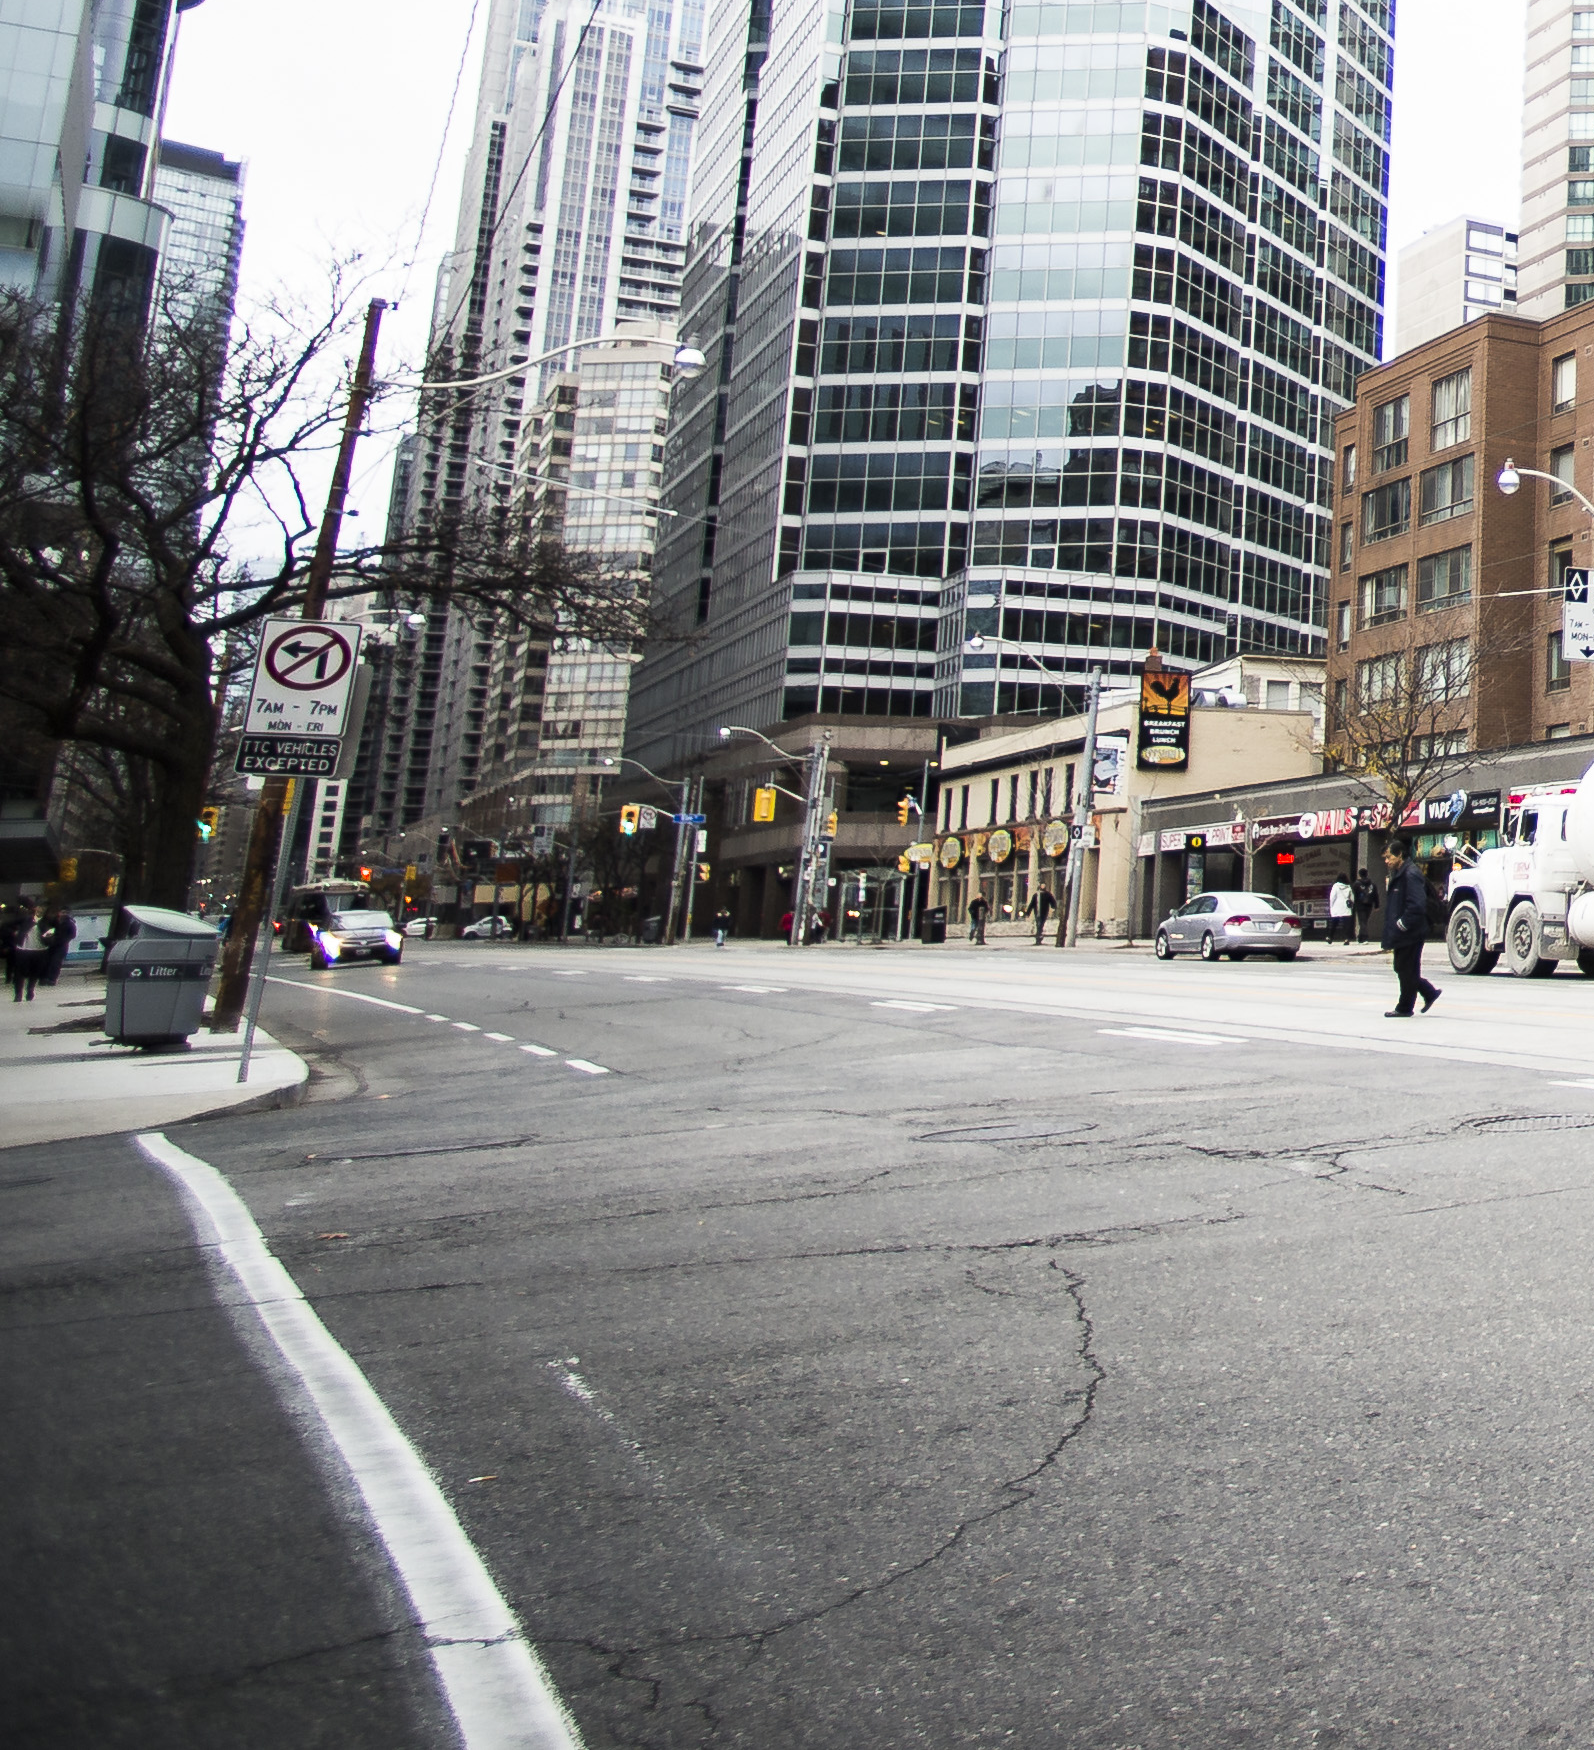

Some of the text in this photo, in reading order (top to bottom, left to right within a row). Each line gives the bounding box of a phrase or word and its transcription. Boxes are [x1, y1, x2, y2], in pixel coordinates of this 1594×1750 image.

[256, 698, 284, 713] 7AM
[310, 700, 338, 715] 7PM
[267, 721, 293, 730] MON
[244, 740, 337, 757] TTC VEHICLES
[243, 756, 329, 770] EXCEPTED
[1428, 800, 1451, 819] VAPE
[1314, 807, 1358, 838] NAILS
[150, 965, 178, 976] Litter
